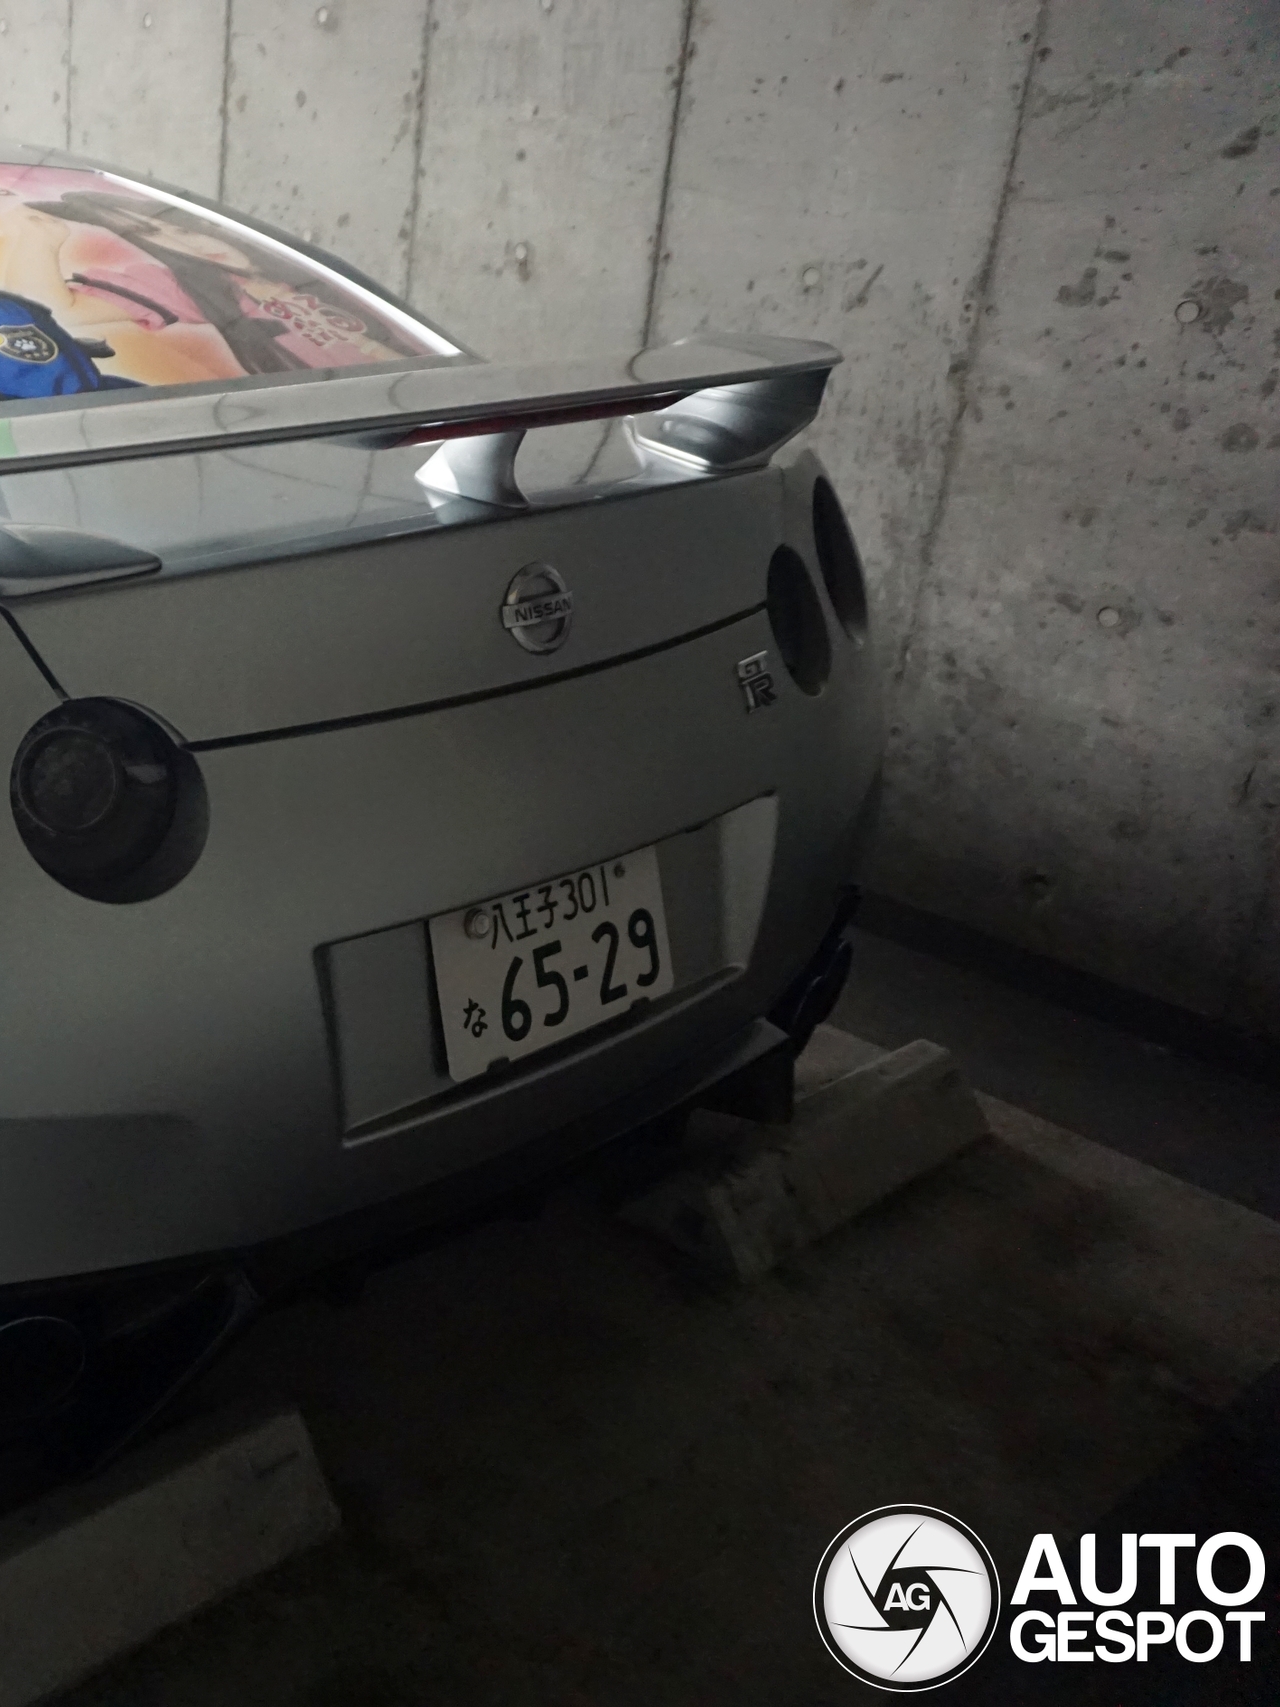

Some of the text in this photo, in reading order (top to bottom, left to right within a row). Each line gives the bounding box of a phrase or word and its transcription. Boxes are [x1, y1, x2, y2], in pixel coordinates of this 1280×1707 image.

[514, 598, 572, 622] NISSAN
[463, 907, 660, 1042] な 65-29
